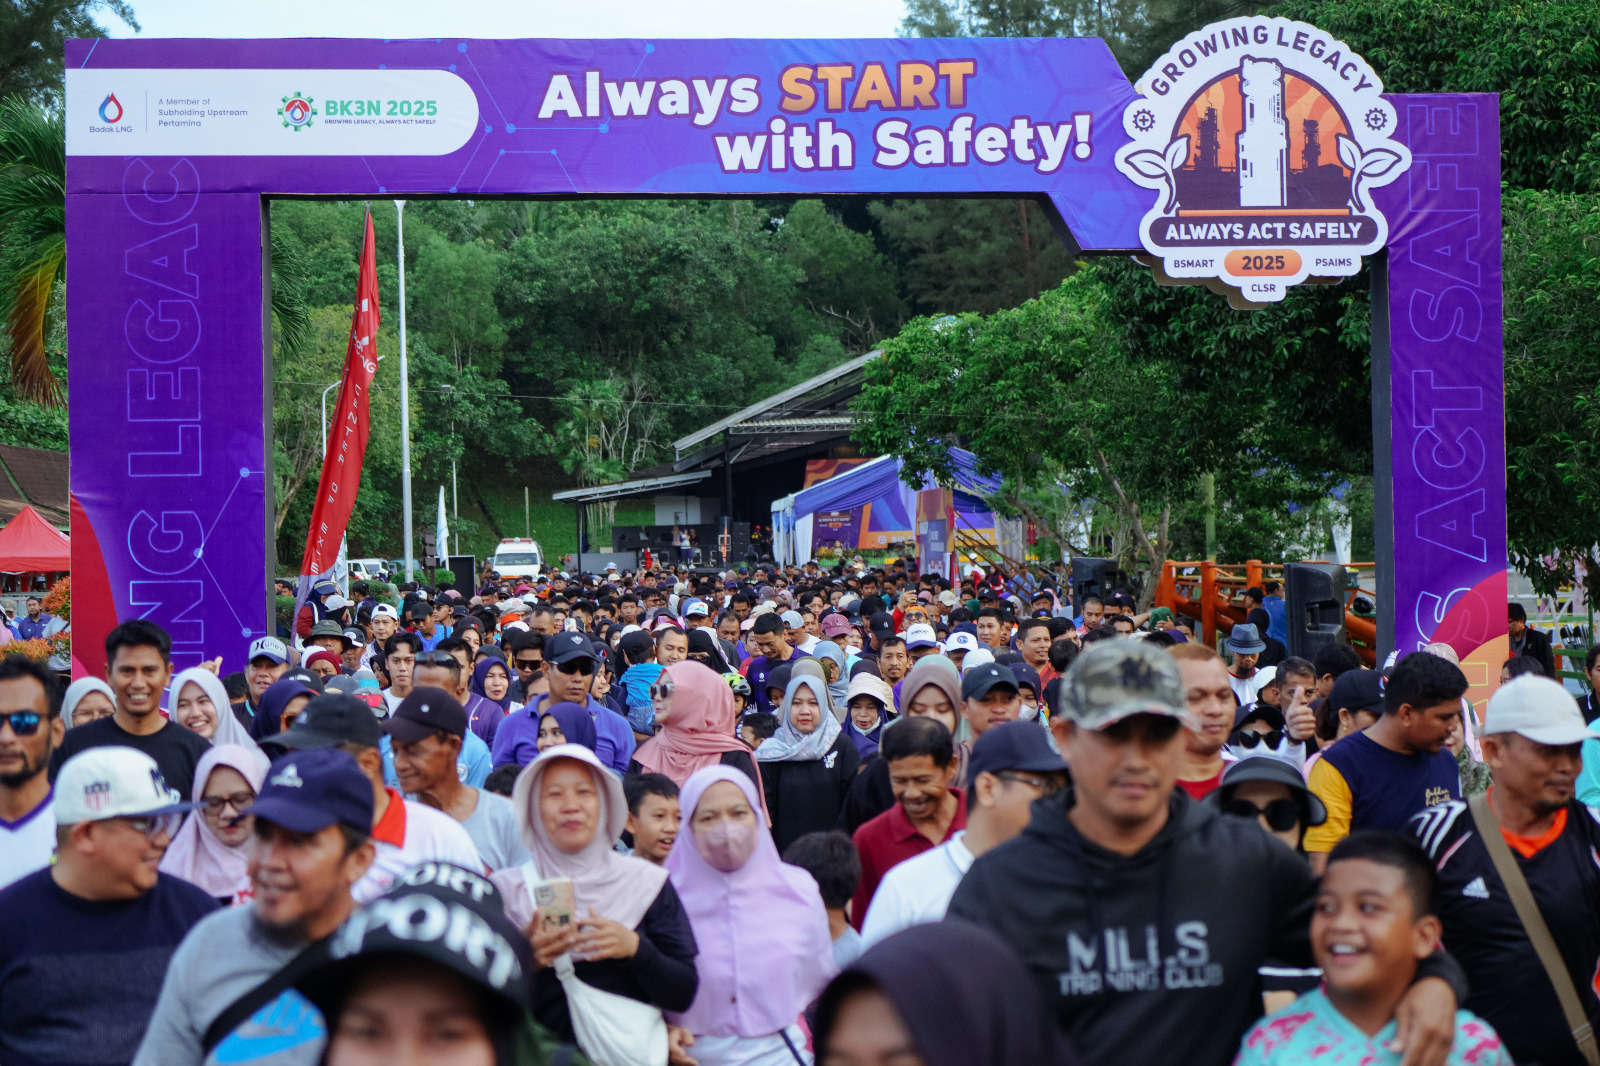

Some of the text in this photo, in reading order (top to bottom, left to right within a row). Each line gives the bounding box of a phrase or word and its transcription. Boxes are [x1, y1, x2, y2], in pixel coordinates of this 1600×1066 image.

[1150, 25, 1373, 97] GROWING LEGACY
[537, 61, 975, 126] Always START
[158, 109, 248, 118] Subholding Upstream
[325, 100, 438, 116] BK3N 2025
[158, 119, 202, 127] Pertamina
[717, 114, 1091, 172] with Safety!
[1406, 93, 1483, 343] SAFE
[1164, 222, 1363, 241] ALWAYS ACT SAFELY
[1173, 258, 1215, 268] BSMART
[1242, 255, 1285, 270] 2025
[1315, 257, 1352, 267] PSAIMS
[1251, 283, 1276, 293] CLSR
[122, 153, 202, 477] LEGAC
[1411, 369, 1487, 563] ACT
